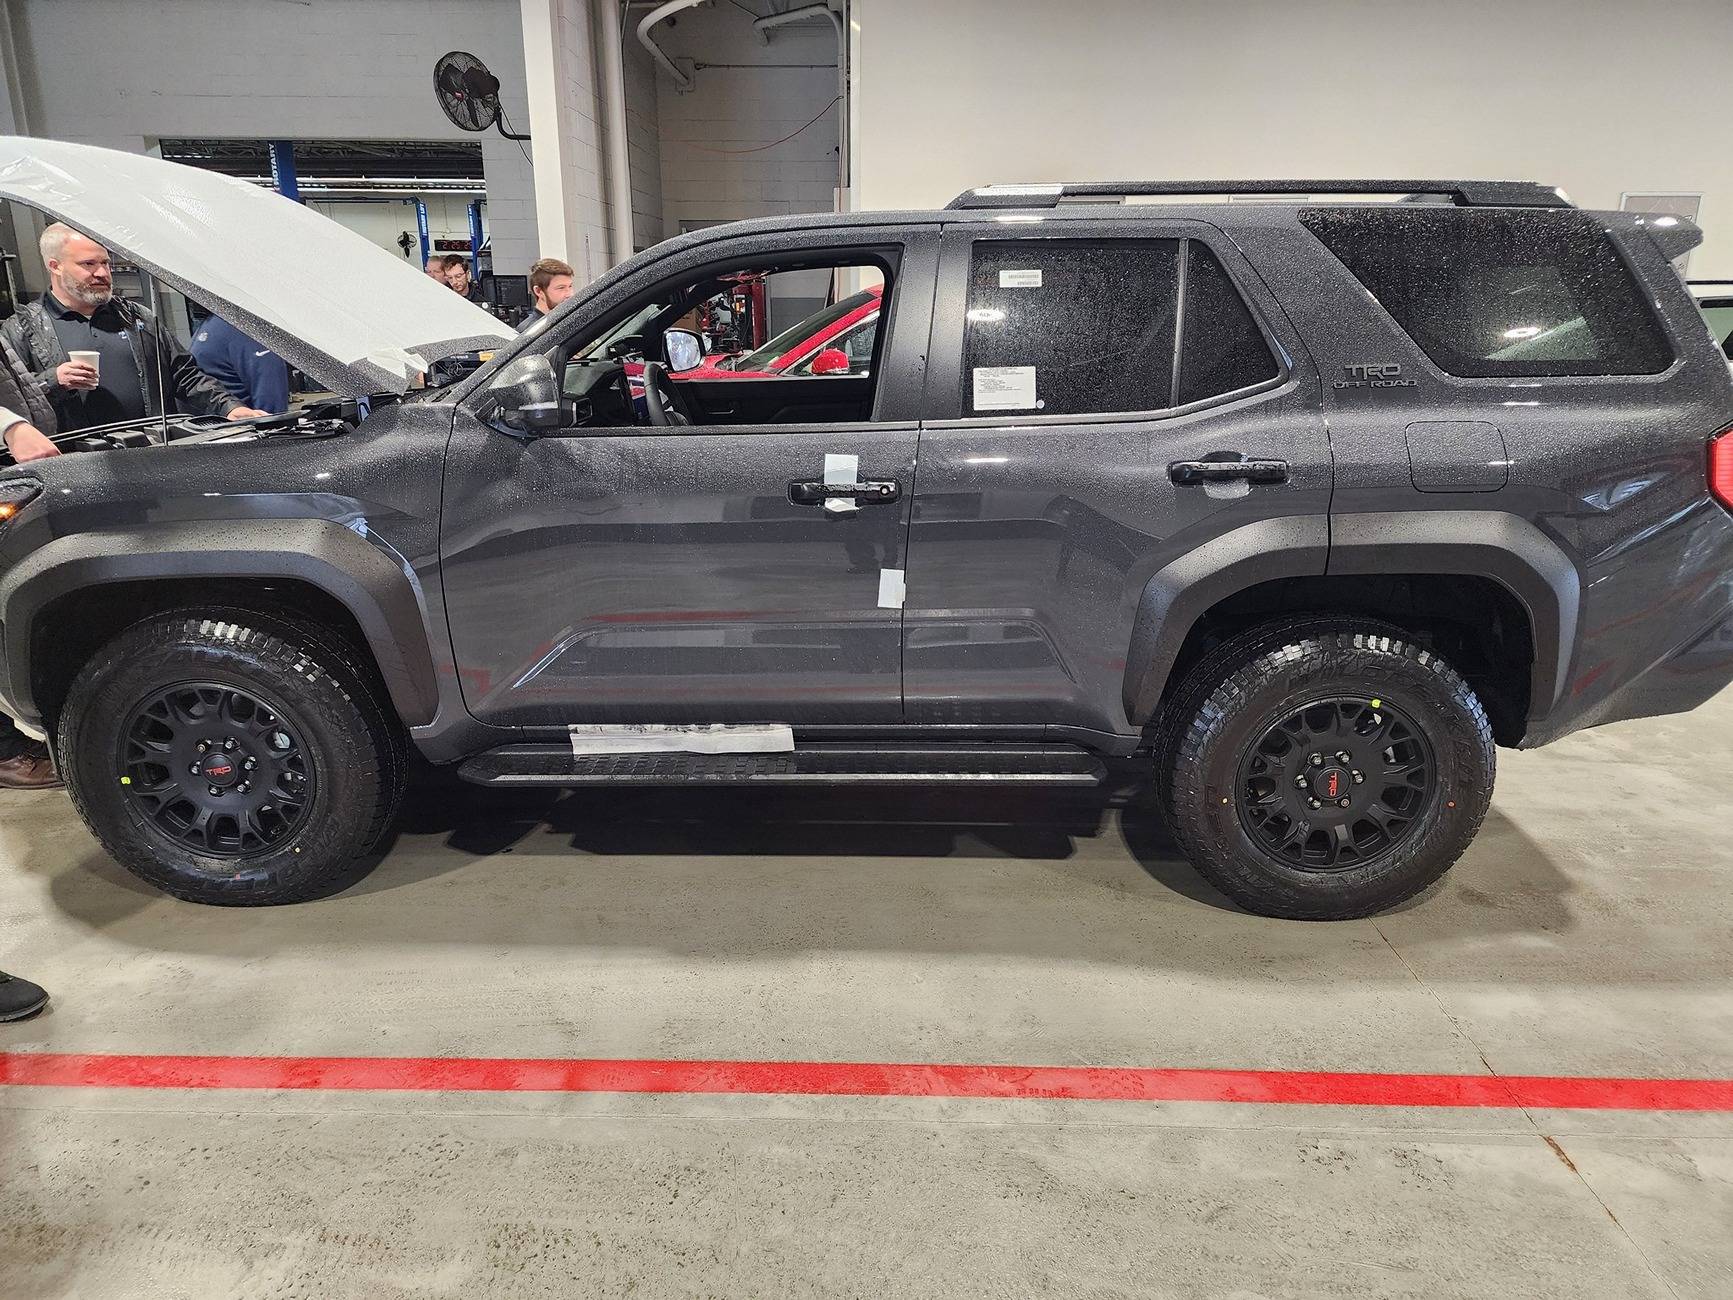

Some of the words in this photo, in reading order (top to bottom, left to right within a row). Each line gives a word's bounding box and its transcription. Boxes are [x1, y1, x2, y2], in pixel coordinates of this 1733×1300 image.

[268, 143, 280, 186] ROTARY
[1344, 363, 1402, 380] TRD
[1333, 381, 1367, 389] OFF
[1371, 379, 1418, 388] ROAD
[205, 765, 232, 776] TRD
[1328, 772, 1338, 797] TRD
